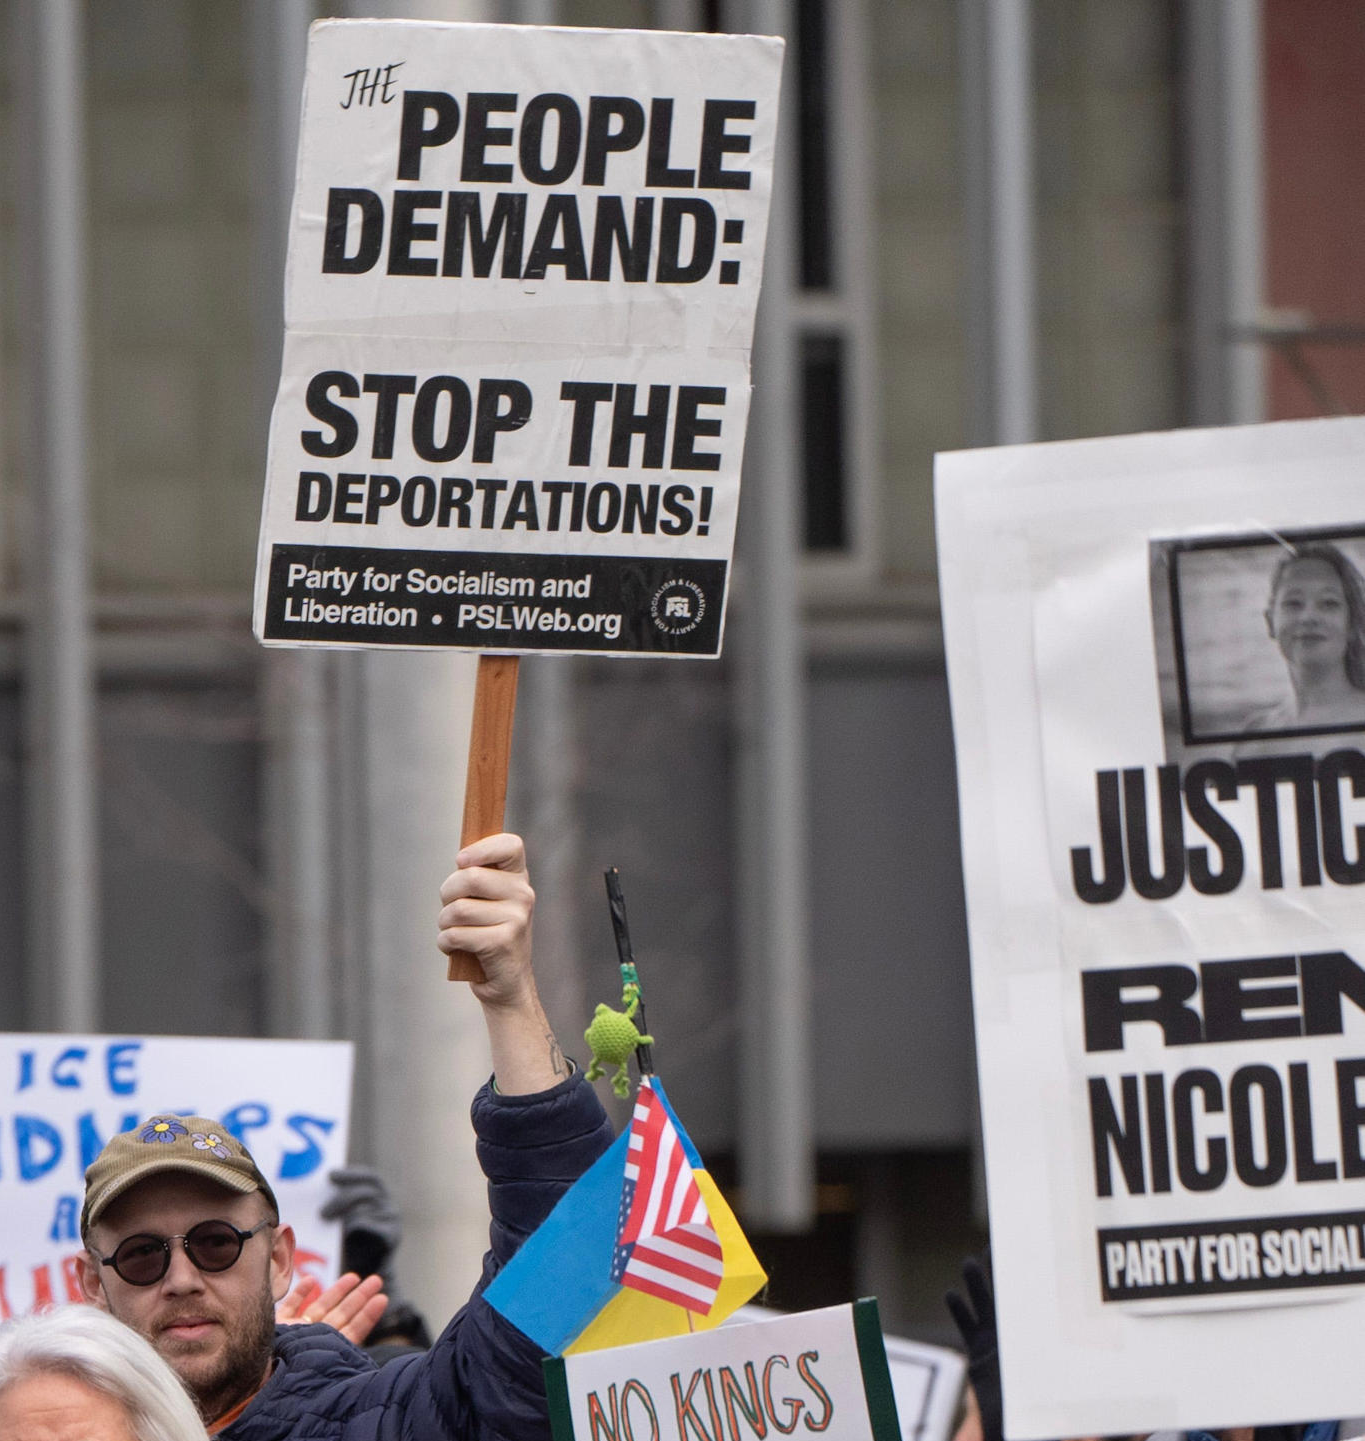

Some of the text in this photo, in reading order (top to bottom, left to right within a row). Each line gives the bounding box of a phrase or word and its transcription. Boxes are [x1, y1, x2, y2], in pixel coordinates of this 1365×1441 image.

[340, 60, 405, 110] THE
[397, 89, 757, 190] PEOPLE
[321, 187, 744, 285] DEMAND:
[300, 370, 727, 471] STOP THE
[295, 472, 714, 536] DEPORTATIONS!
[287, 563, 592, 599] Party for Socialism and
[284, 598, 622, 640] Liberation PSLWeb.org
[1069, 748, 1365, 905] JUSTIC
[1080, 951, 1365, 1053] REN
[16, 1041, 142, 1096] ICE
[1105, 1223, 1365, 1289] PARTY FOR SOCIAL
